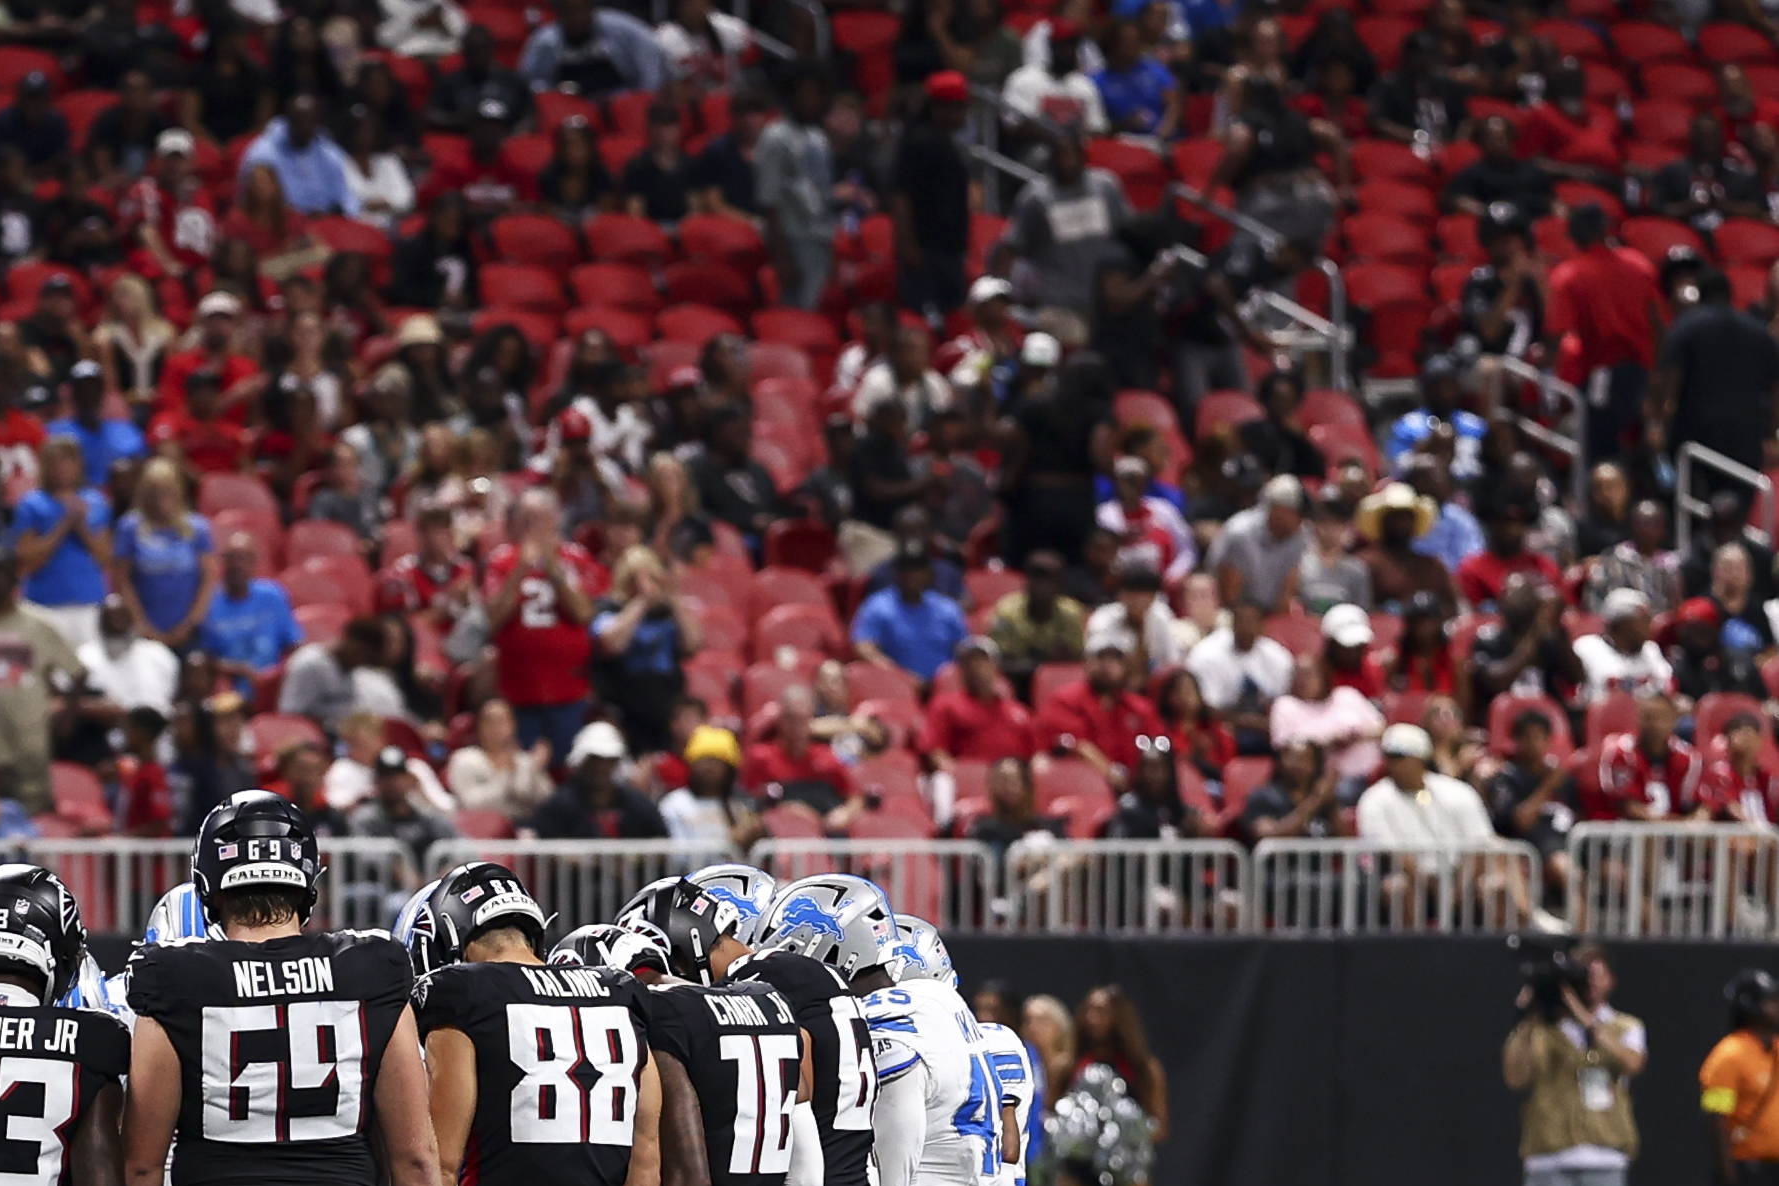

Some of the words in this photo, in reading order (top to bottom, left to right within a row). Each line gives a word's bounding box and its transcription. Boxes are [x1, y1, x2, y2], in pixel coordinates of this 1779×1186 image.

[519, 577, 556, 628] 2
[248, 840, 281, 860] 69
[228, 869, 302, 883] FALCONS
[489, 879, 522, 895] 88
[233, 957, 333, 997] NELSON
[520, 966, 611, 998] KALINIC
[44, 1019, 80, 1055] JR
[202, 1000, 370, 1143] 69
[506, 1003, 647, 1147] 88
[719, 1034, 800, 1174] 16
